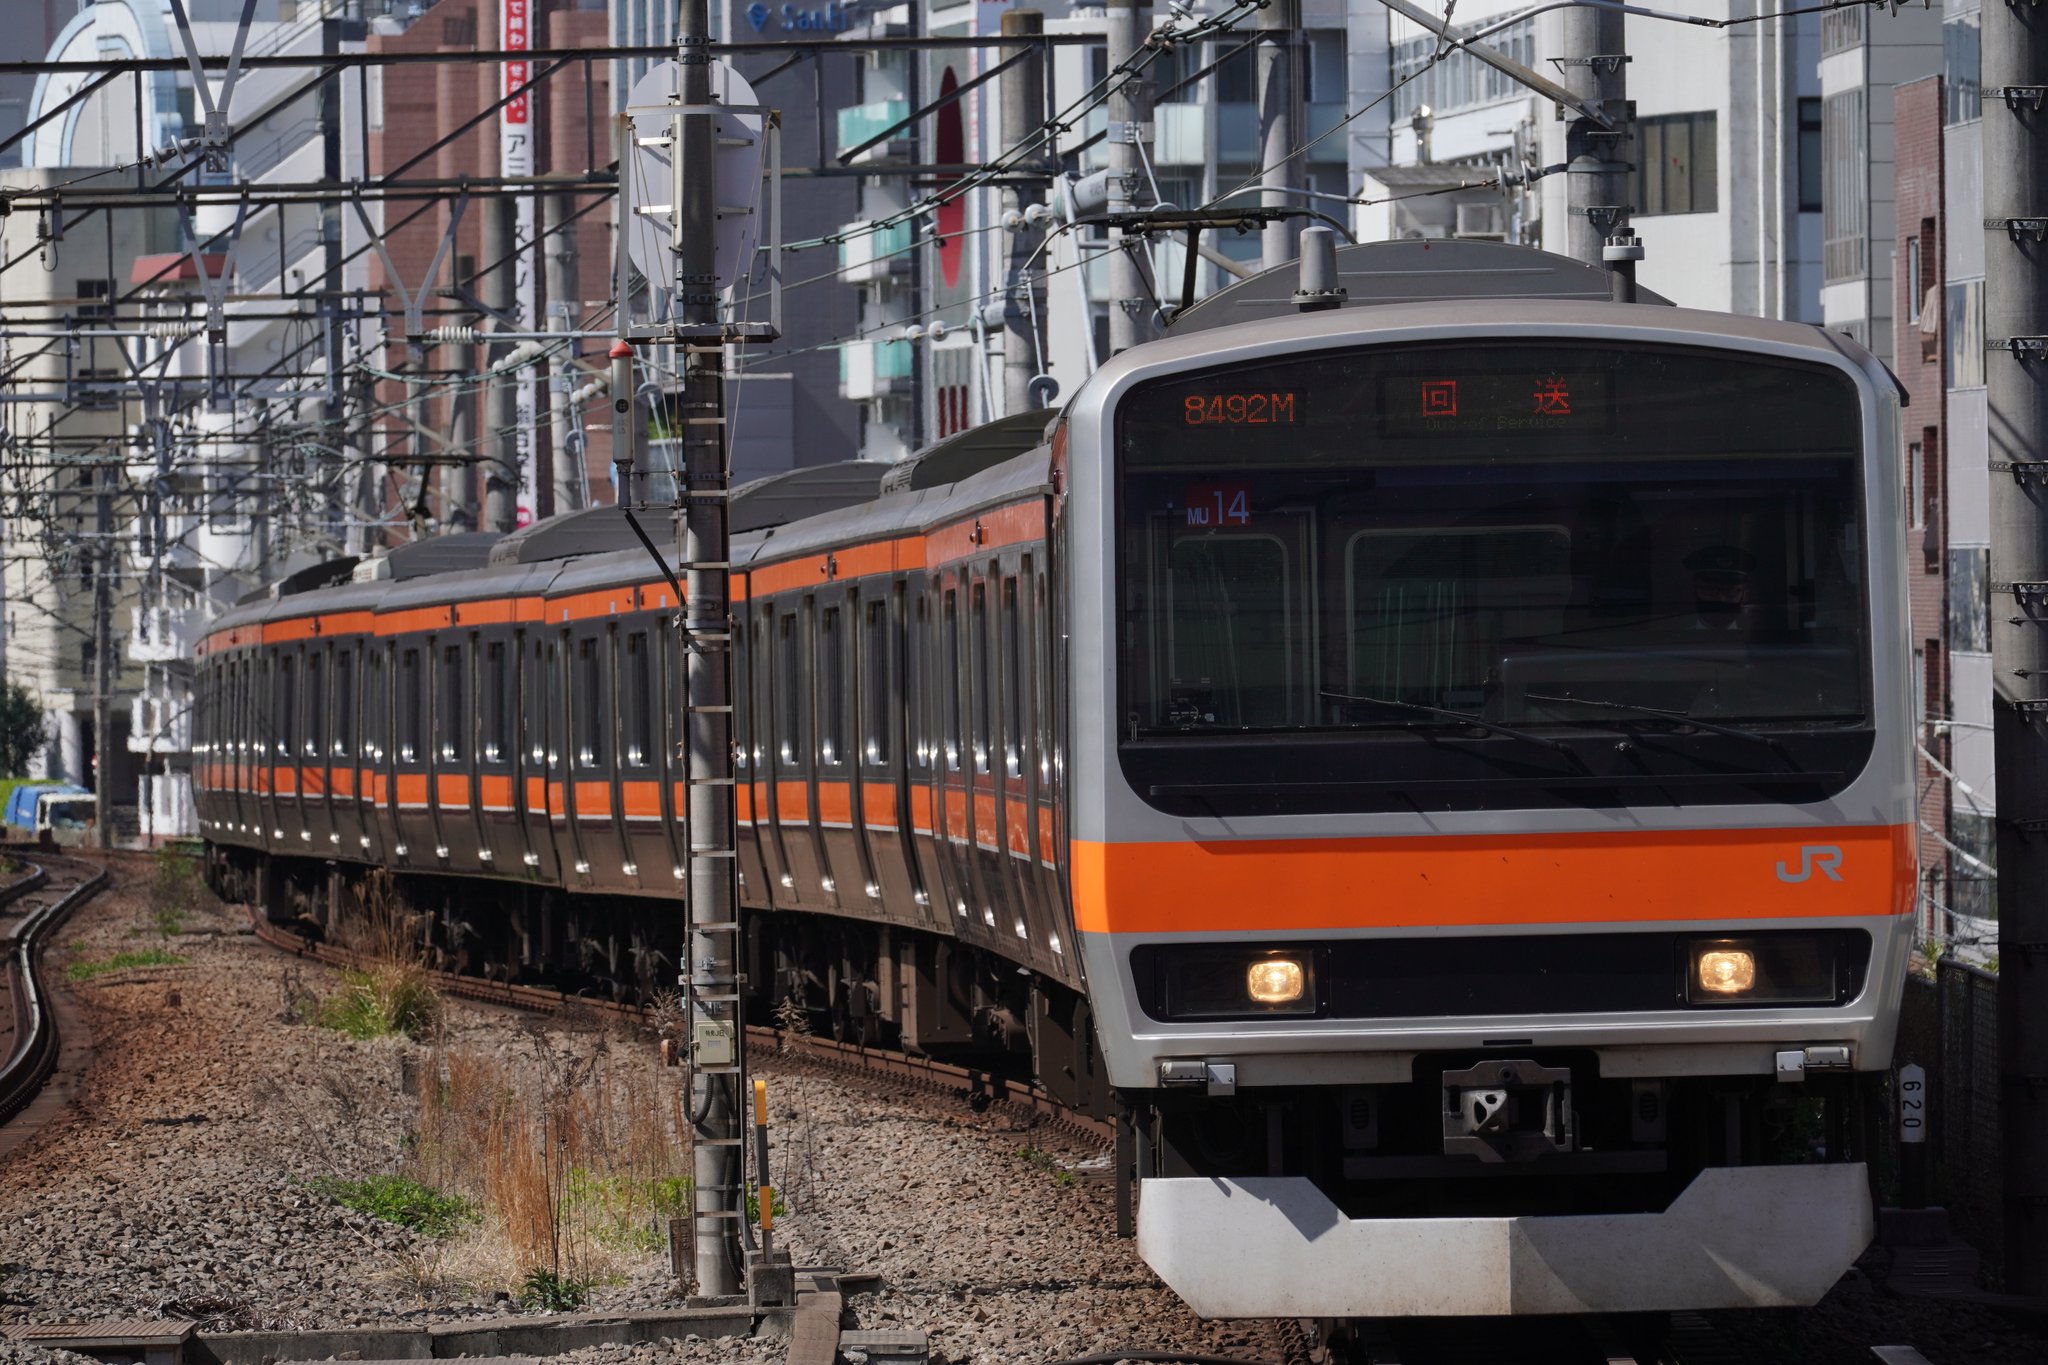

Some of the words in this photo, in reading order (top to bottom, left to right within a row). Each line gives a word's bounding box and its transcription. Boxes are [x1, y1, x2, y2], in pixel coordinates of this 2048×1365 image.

[1184, 393, 1294, 425] 8492M
[1187, 507, 1209, 525] MU
[1213, 490, 1250, 524] 14
[1775, 845, 1845, 883] JR
[1902, 1080, 1922, 1128] 620
